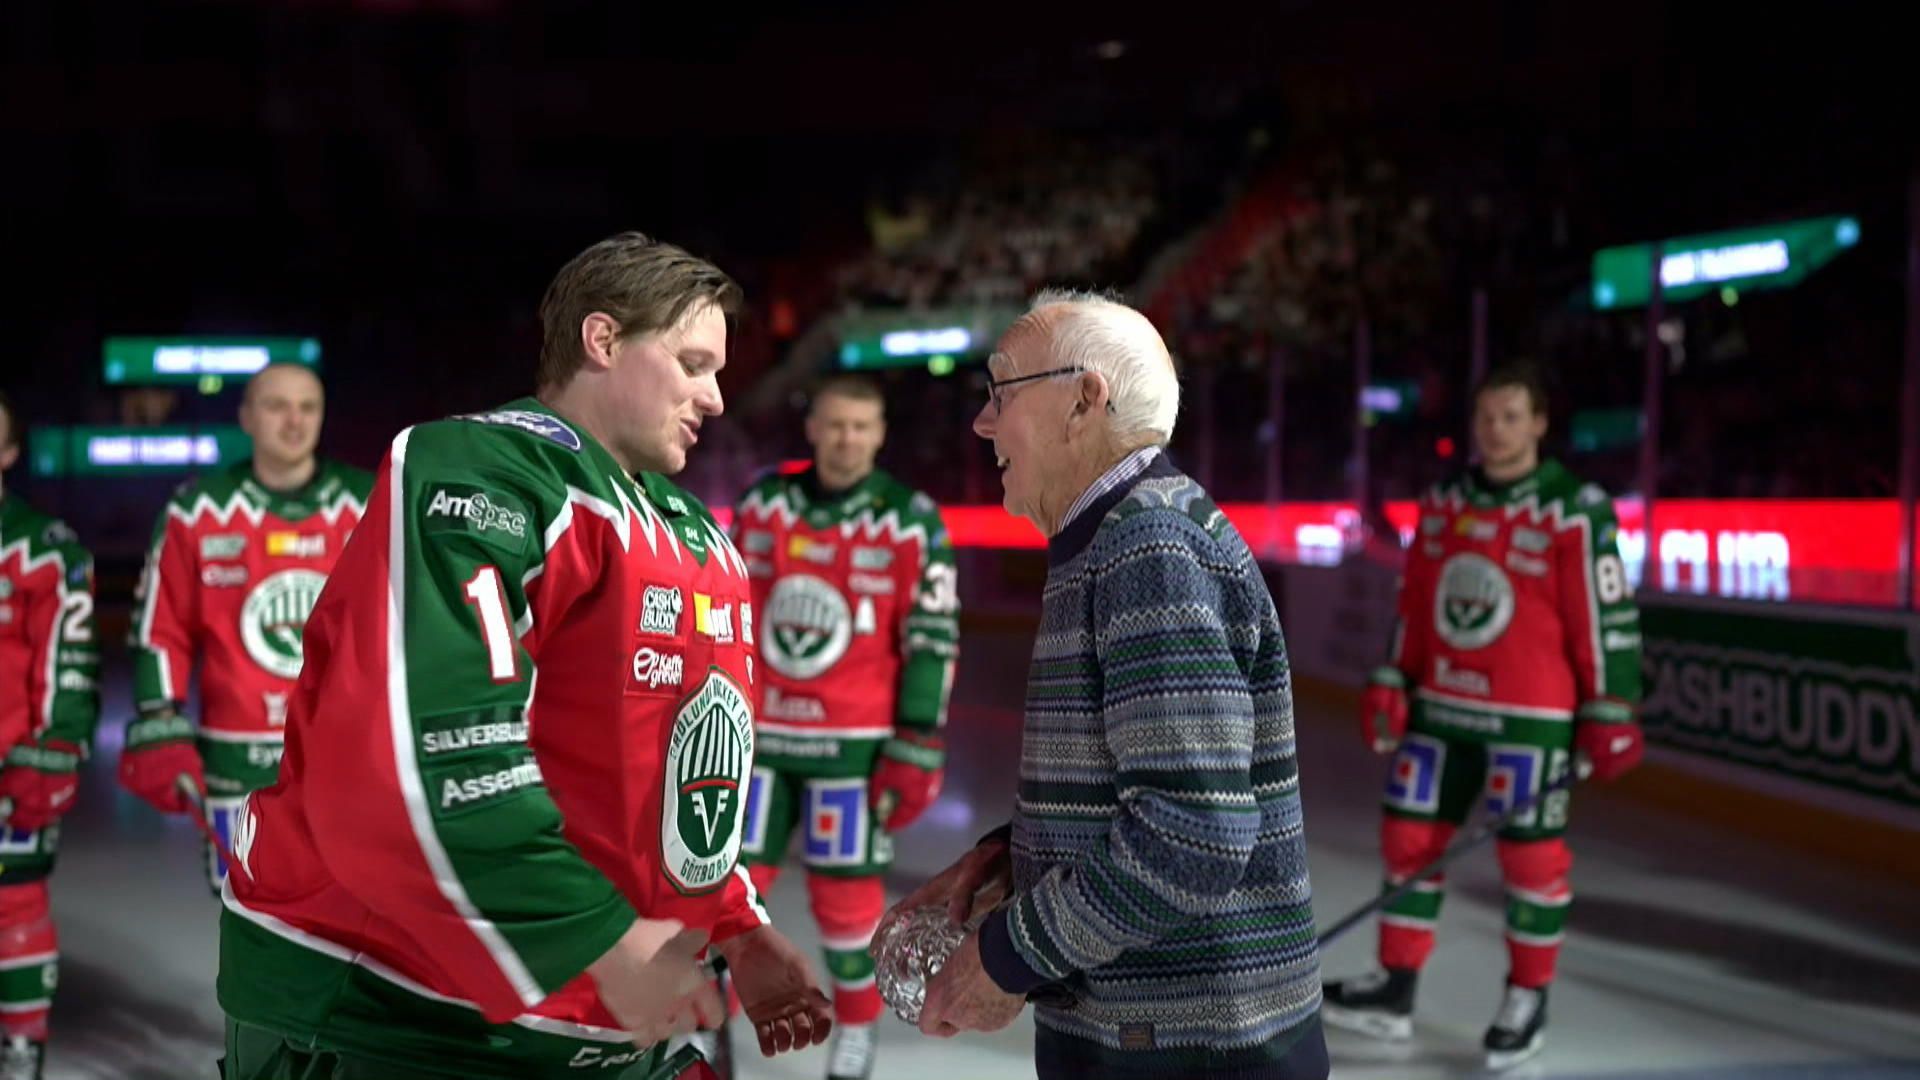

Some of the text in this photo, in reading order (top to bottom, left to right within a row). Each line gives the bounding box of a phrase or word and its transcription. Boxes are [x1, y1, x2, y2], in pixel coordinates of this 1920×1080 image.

[426, 489, 526, 538] AmSpec
[464, 564, 518, 682] 1
[643, 608, 676, 631] BUDDY
[645, 590, 672, 612] CASH
[1642, 656, 1920, 773] ASHBUDDY
